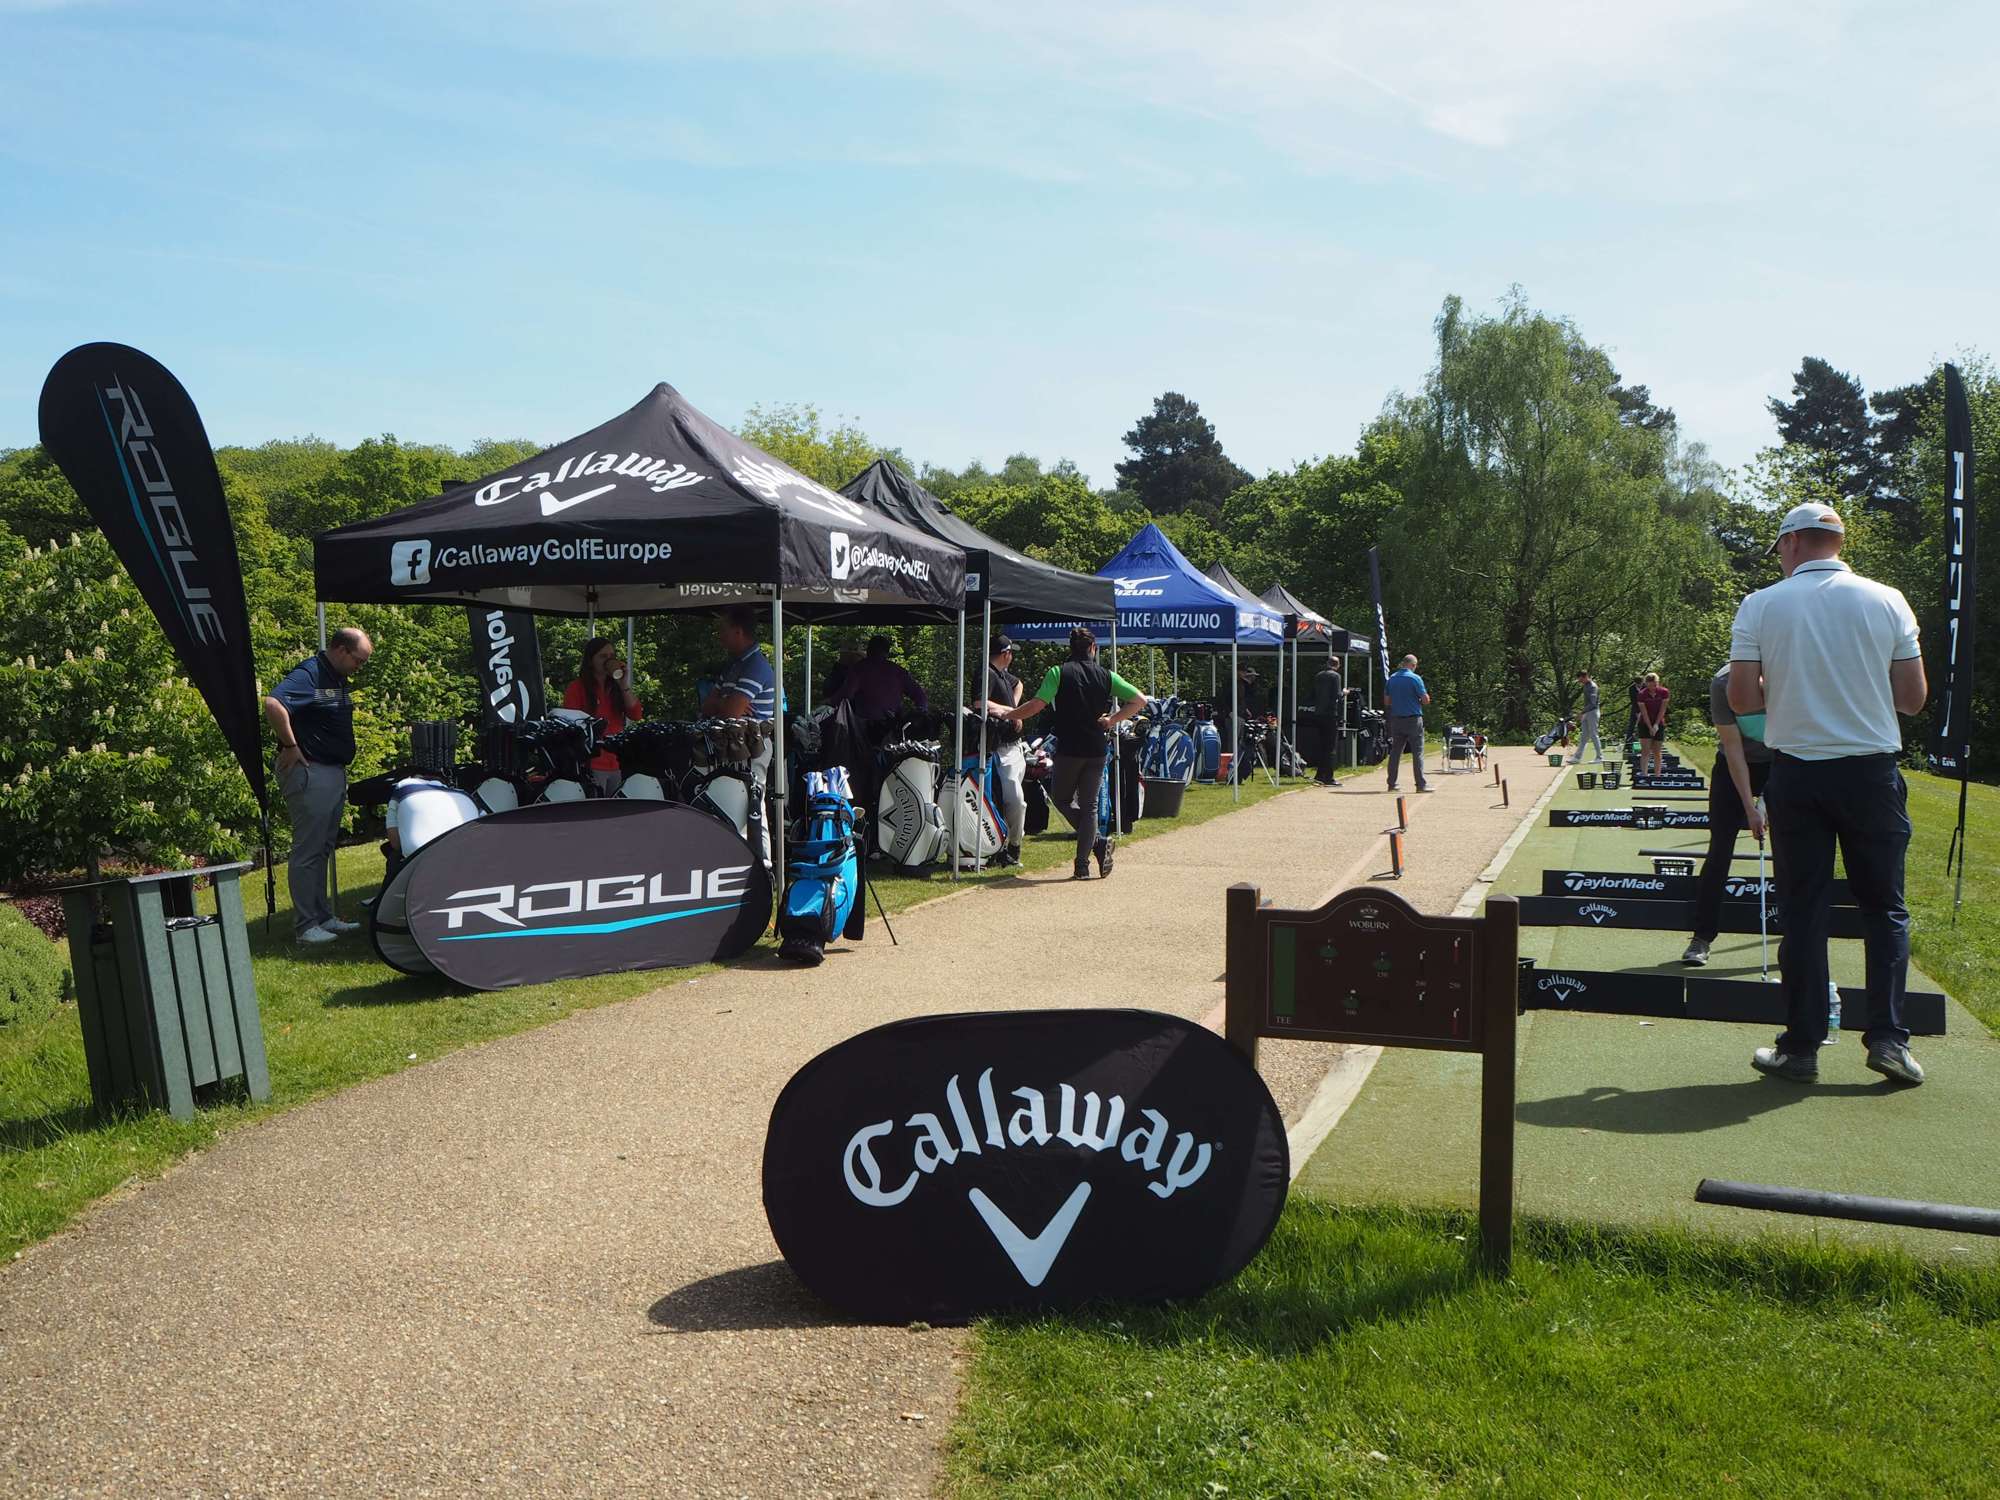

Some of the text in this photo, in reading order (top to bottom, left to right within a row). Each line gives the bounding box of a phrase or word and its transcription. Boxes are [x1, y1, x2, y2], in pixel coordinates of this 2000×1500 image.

[474, 451, 706, 506] Callaway
[106, 371, 226, 644] ROGUE
[434, 539, 672, 569] /CallawayGolfEurope
[1566, 811, 1710, 825] TaylorMade TaylorM
[1563, 872, 1665, 891] TaylorMade
[428, 865, 752, 929] ROGUE
[1578, 902, 1618, 918] Callaway
[1537, 973, 1587, 993] Callaway
[843, 1067, 1212, 1207] Callaway
